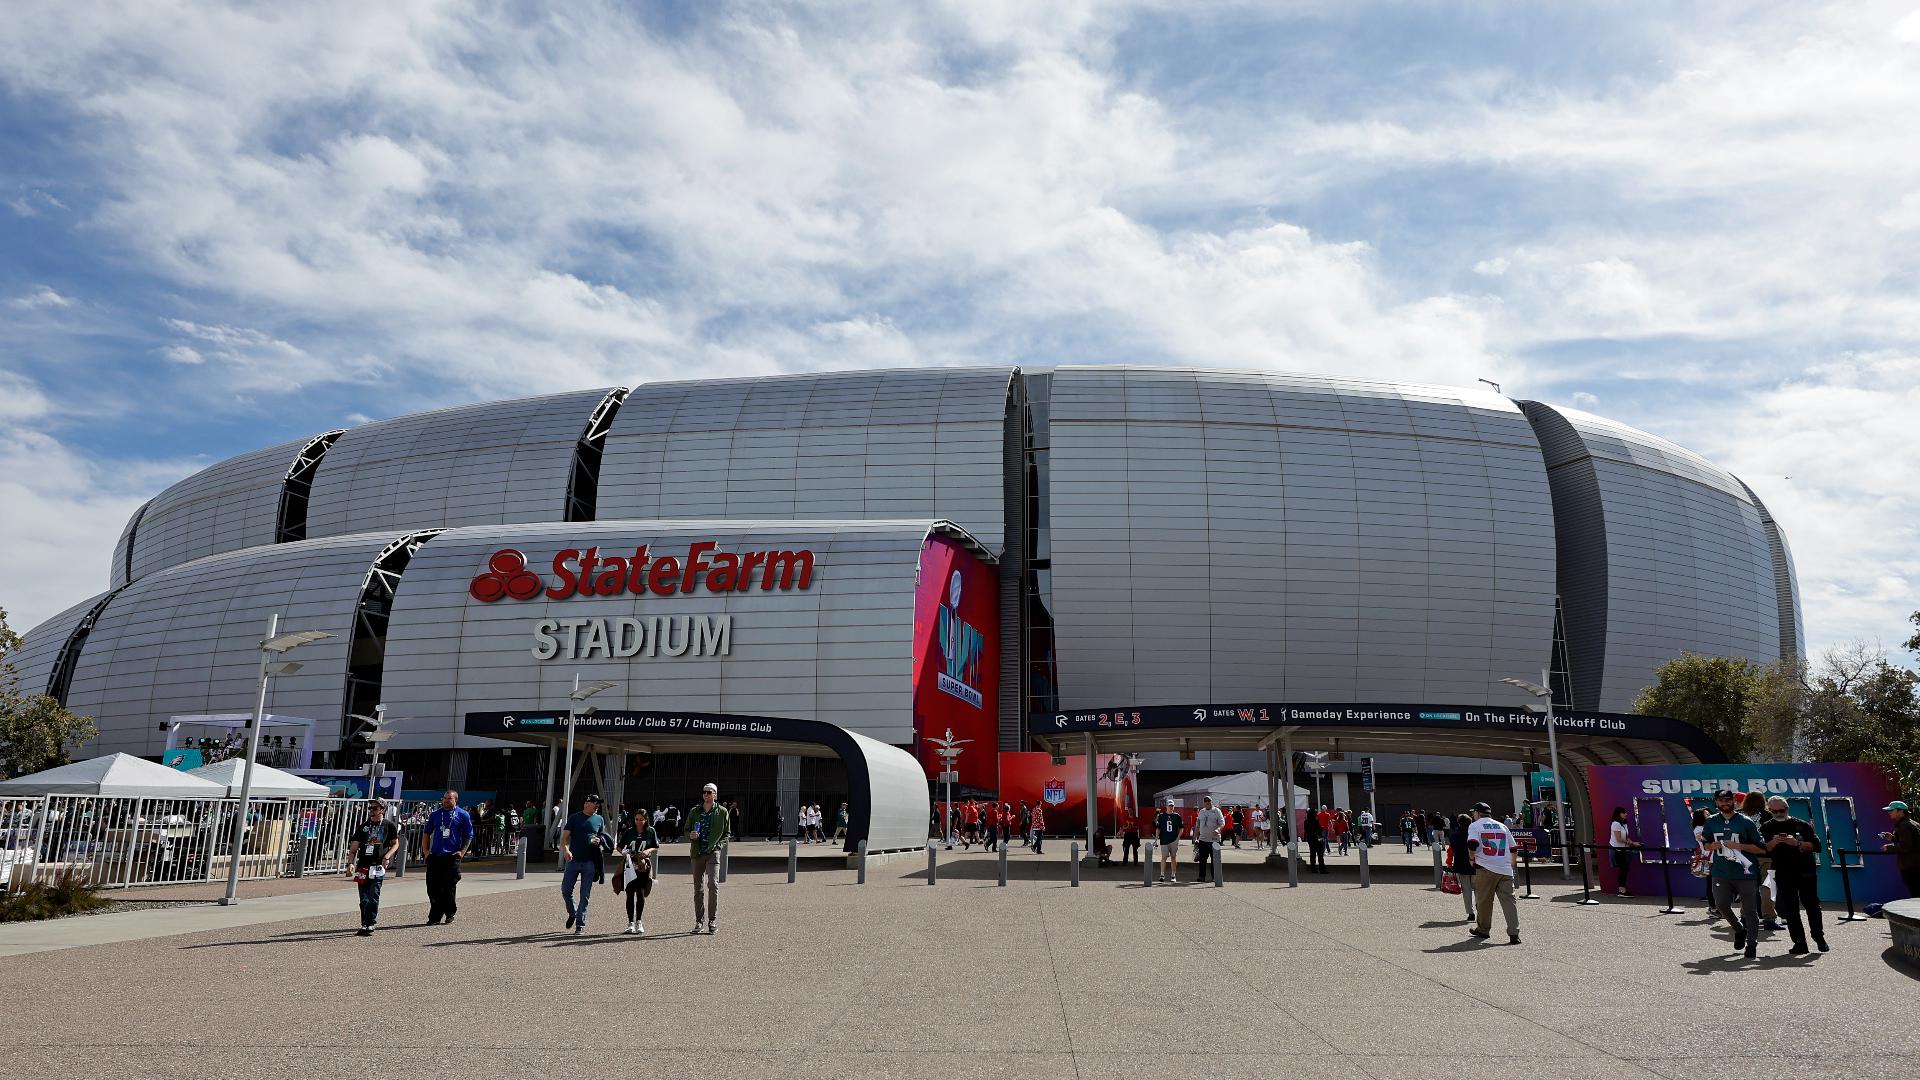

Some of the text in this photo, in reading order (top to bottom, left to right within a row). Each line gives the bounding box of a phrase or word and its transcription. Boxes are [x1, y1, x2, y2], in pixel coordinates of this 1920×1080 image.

[530, 614, 732, 661] STADIUM
[942, 677, 979, 704] SUPER BOWL
[1075, 712, 1141, 727] GATES 2, E, 3
[1213, 708, 1270, 722] GATES W, 1
[1291, 709, 1343, 721] Gameday
[1346, 709, 1411, 720] Experience
[1465, 712, 1480, 722] On
[1484, 712, 1505, 723] The
[1509, 713, 1538, 726] Fifty
[1552, 716, 1596, 728] Kickoff
[1599, 719, 1626, 730] Club
[558, 716, 612, 726] Tochdown
[614, 717, 636, 727] Club
[645, 717, 666, 727] Club
[669, 718, 682, 728] 57
[692, 719, 747, 731] Champions
[750, 722, 772, 733] Club
[1641, 778, 1838, 794] SUPER BOWL
[1046, 789, 1064, 801] NFL
[1166, 820, 1173, 832] 6
[629, 840, 647, 853] 14
[1480, 832, 1507, 857] 57
